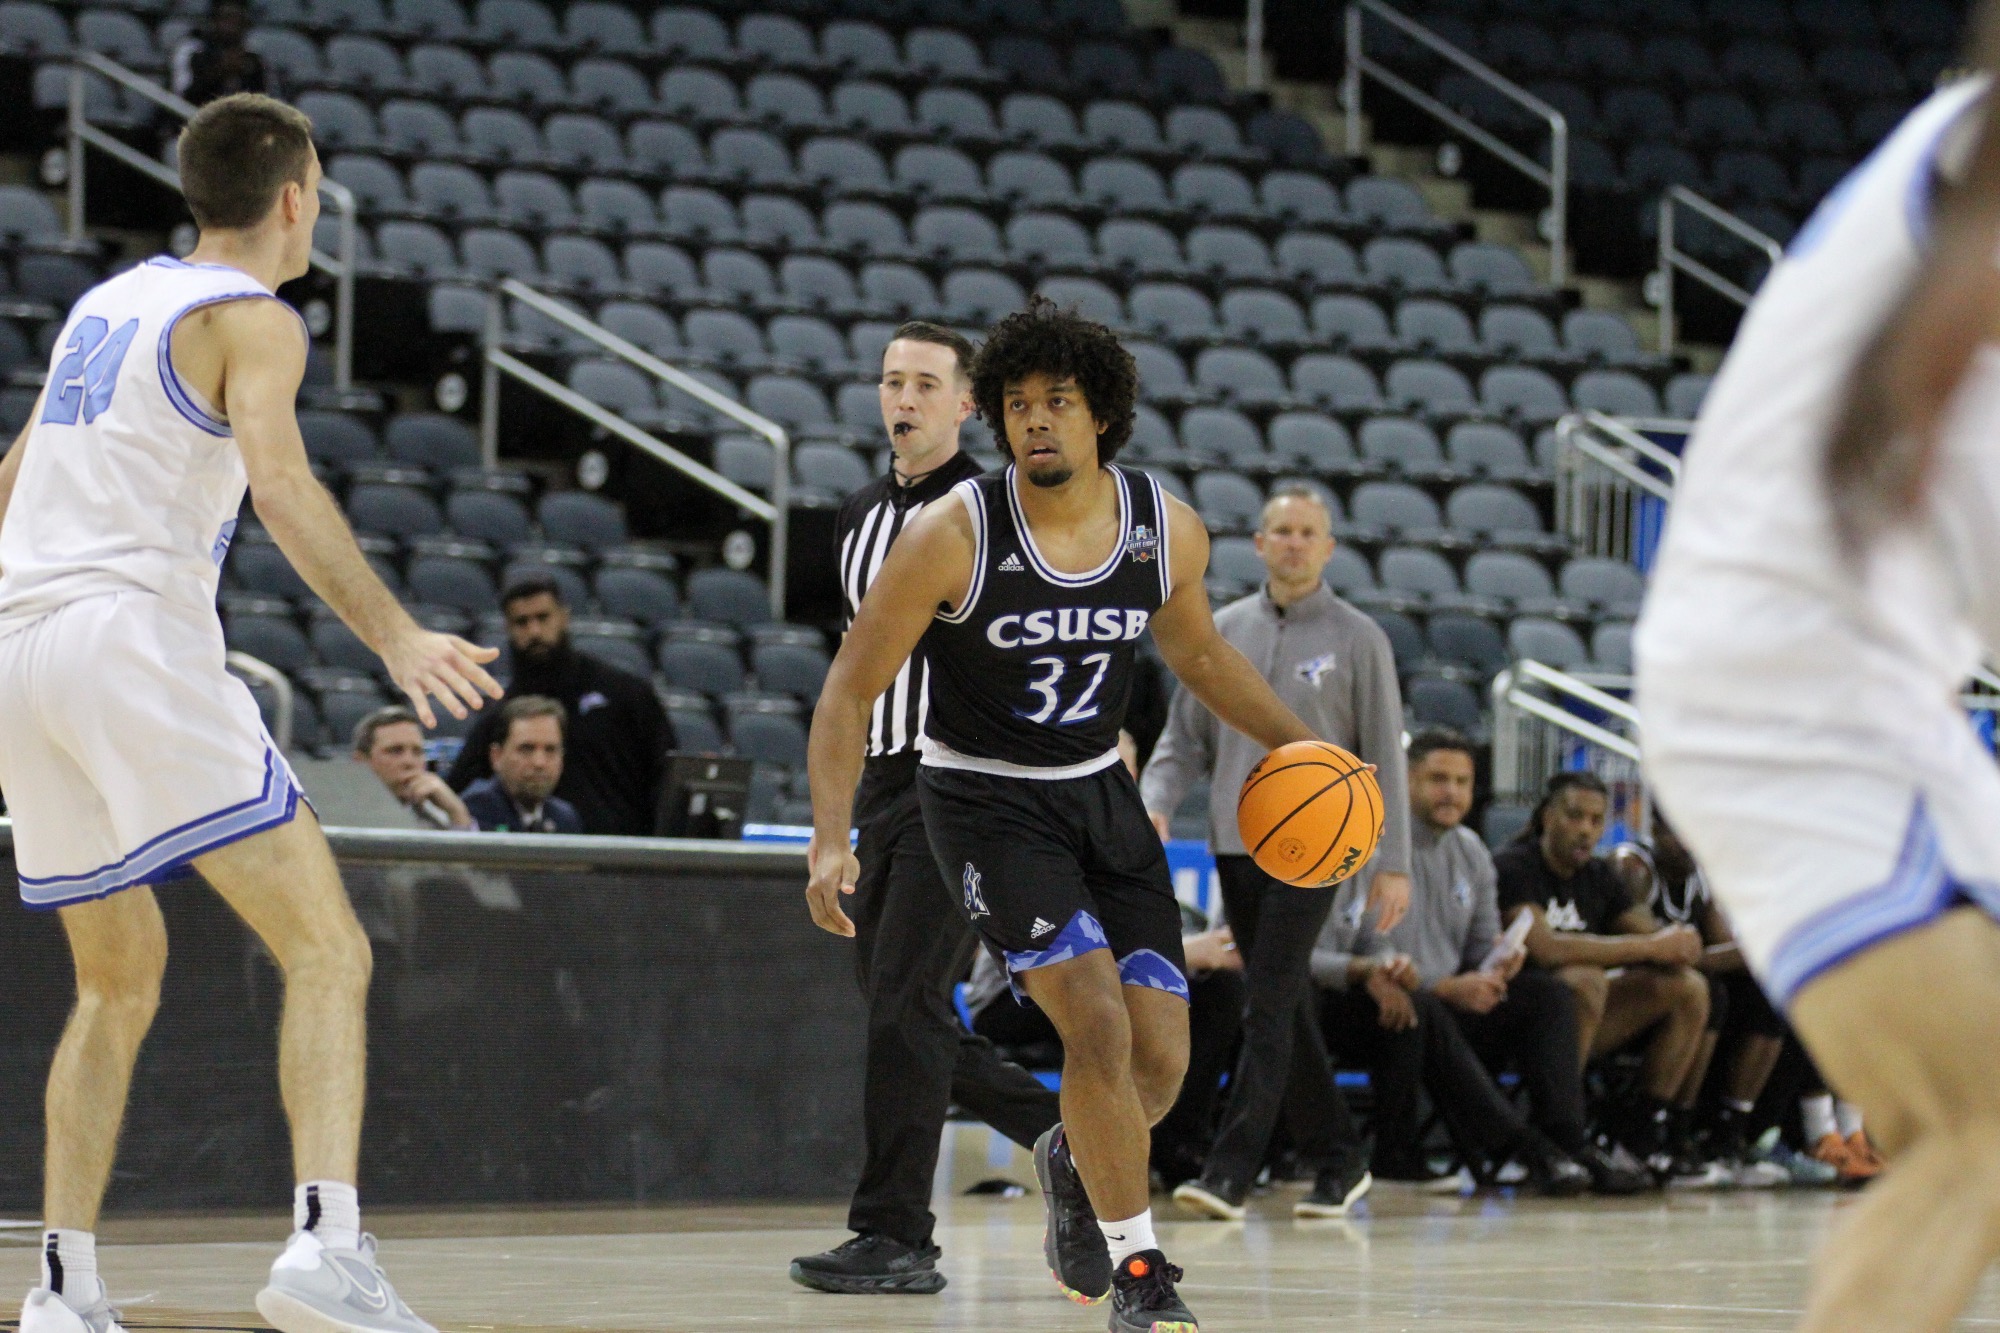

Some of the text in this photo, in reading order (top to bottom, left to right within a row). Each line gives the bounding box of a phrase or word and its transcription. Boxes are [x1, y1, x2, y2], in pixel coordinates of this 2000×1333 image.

[40, 315, 139, 426] 20
[986, 608, 1149, 649] CSUSB
[1014, 652, 1113, 726] 32
[1030, 923, 1056, 939] adidas
